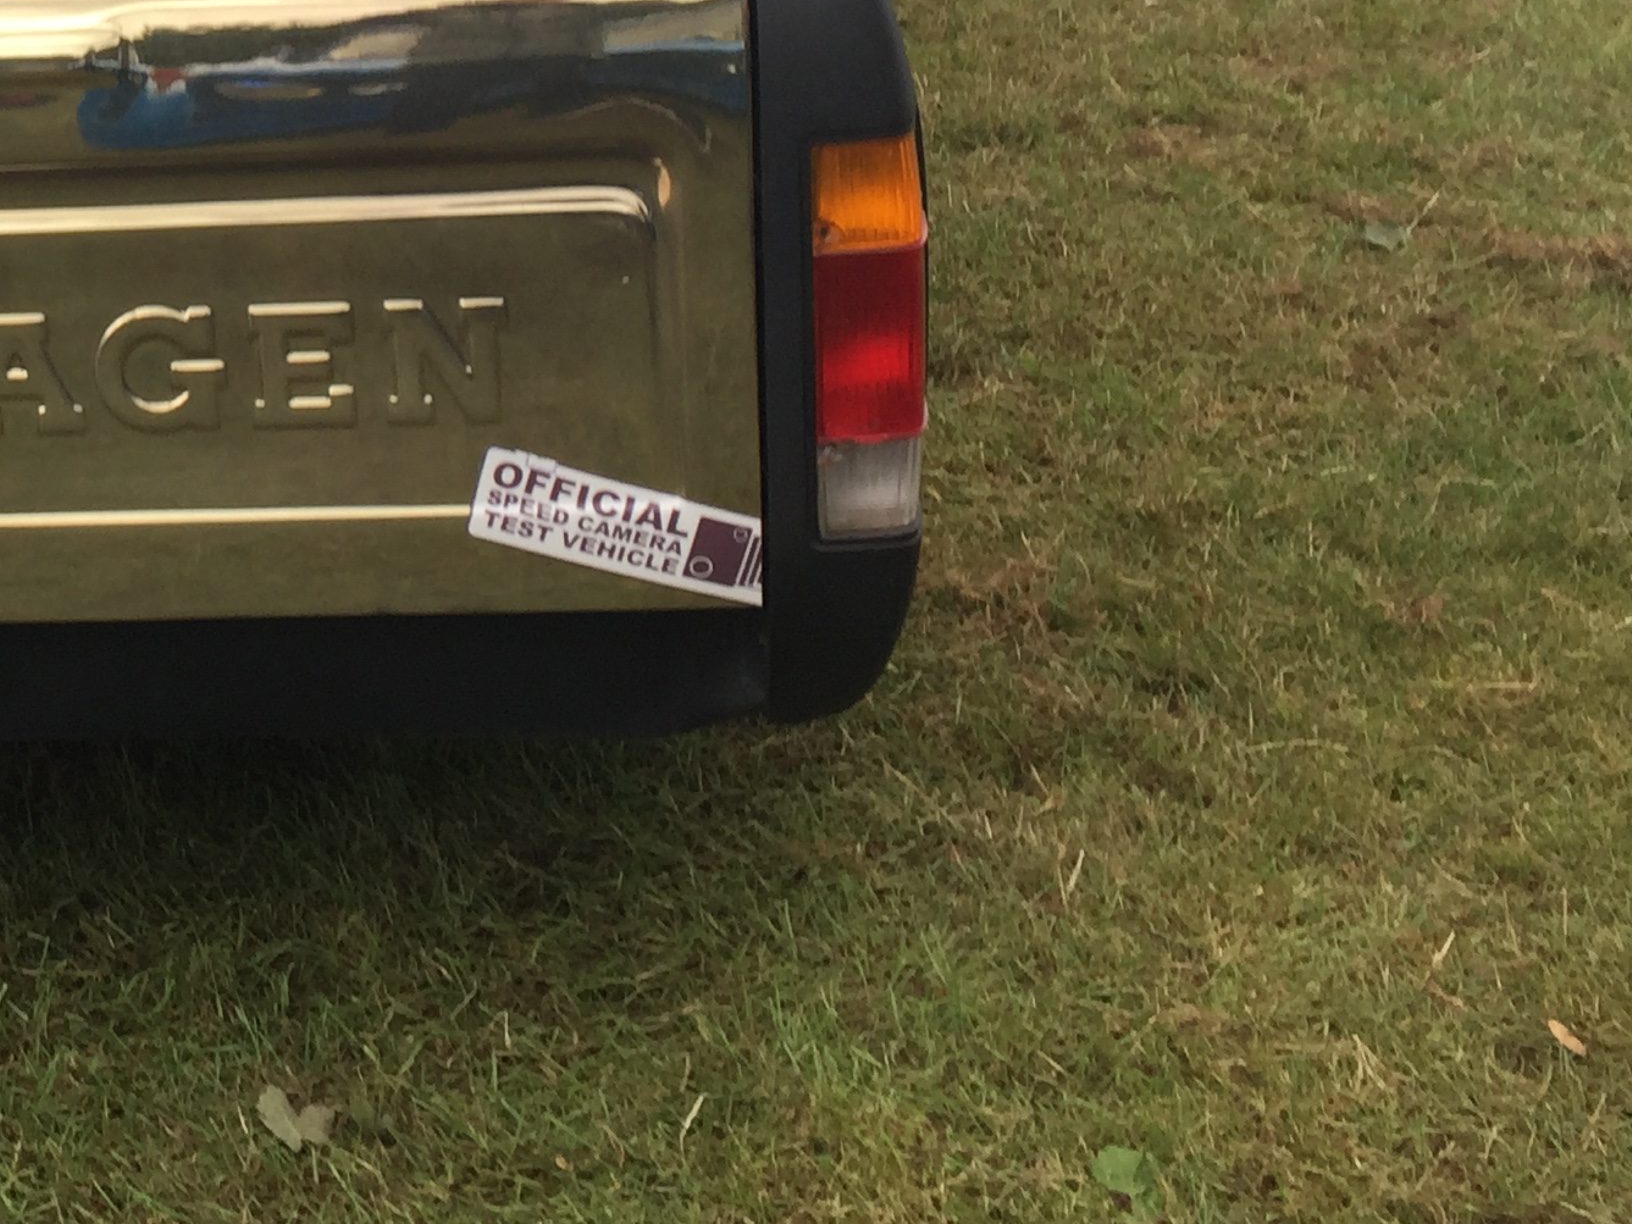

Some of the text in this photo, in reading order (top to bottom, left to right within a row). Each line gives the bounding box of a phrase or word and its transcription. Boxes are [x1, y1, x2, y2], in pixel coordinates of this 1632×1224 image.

[487, 489, 682, 556] SPEED CAMERA
[492, 462, 688, 538] OFFICIAL
[484, 509, 680, 575] TEST VEHICLE
